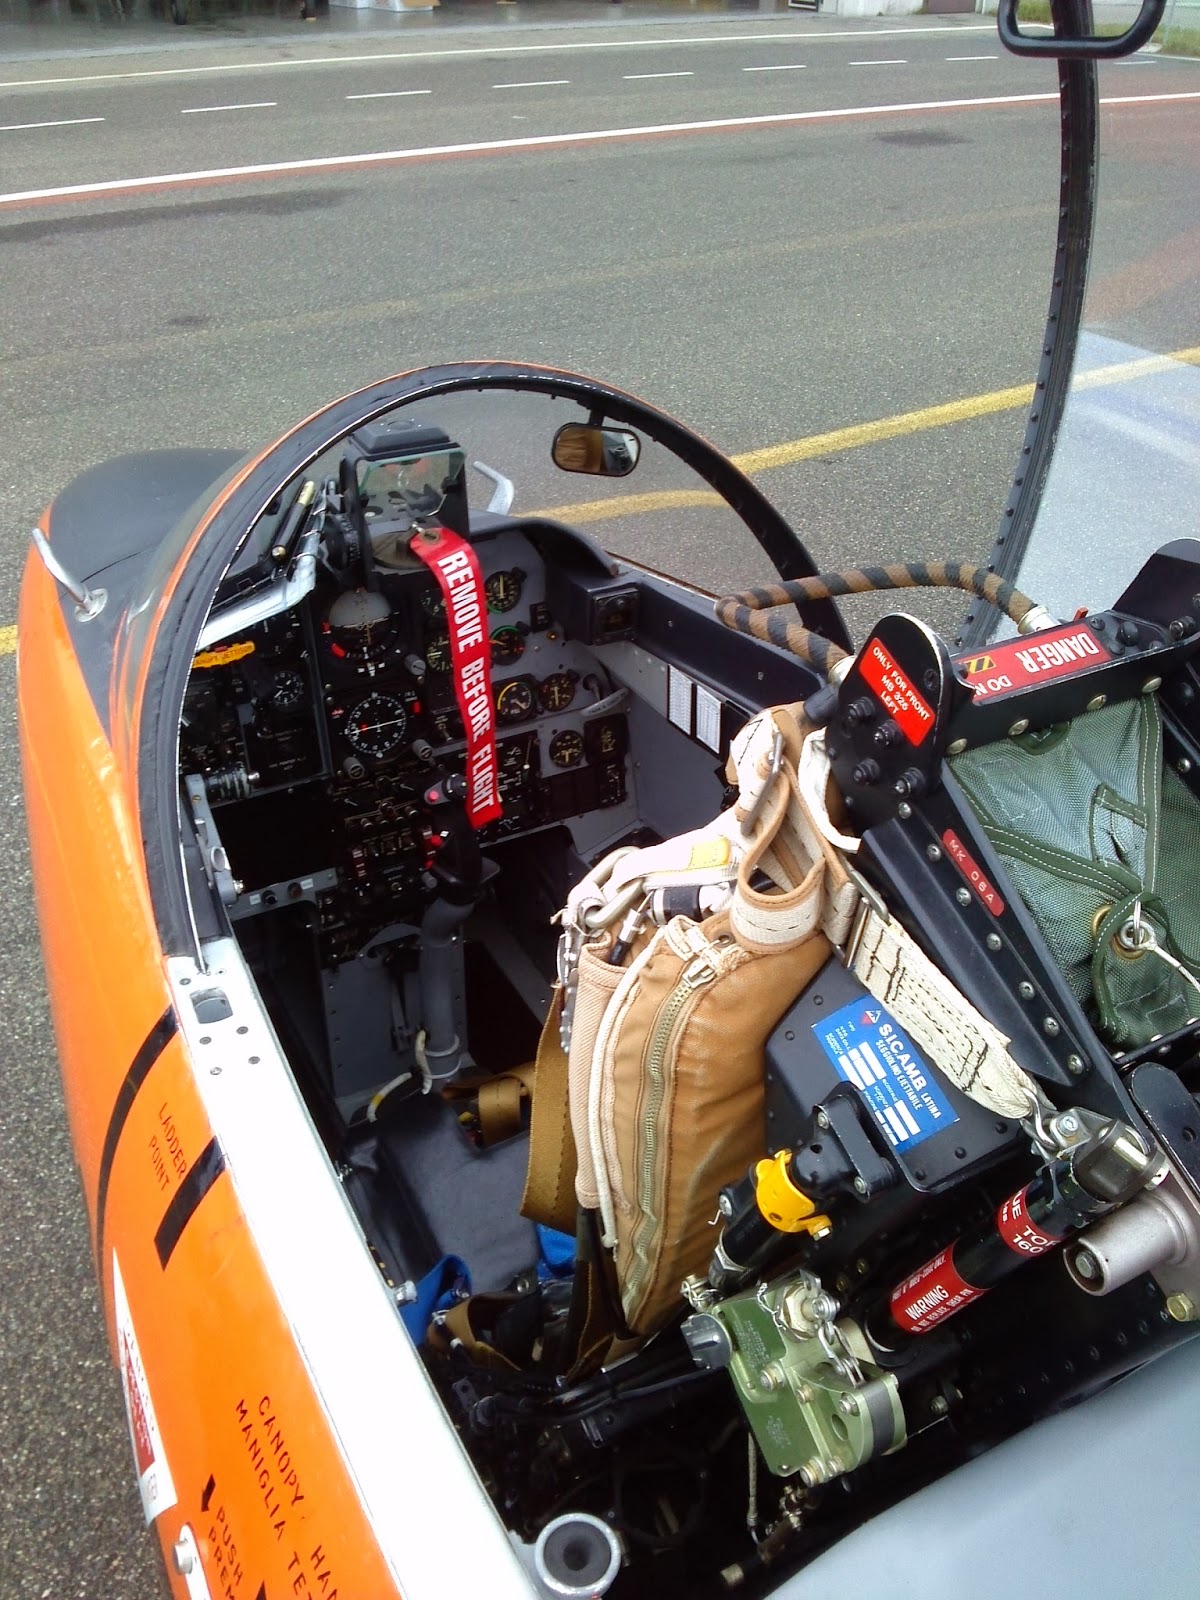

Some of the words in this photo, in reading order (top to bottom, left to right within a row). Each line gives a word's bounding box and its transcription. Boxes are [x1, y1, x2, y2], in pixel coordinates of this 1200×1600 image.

[437, 550, 483, 653] REMOVE
[1014, 632, 1100, 673] DANGER
[460, 656, 491, 739] BEFORE
[872, 646, 892, 671] ONLY
[890, 669, 907, 690] FOR
[905, 688, 931, 722] FRONT
[880, 691, 900, 715] LEFT
[881, 674, 896, 693] MB
[894, 691, 909, 712] 326
[987, 675, 1013, 692] DO
[472, 742, 495, 814] FLIGHT
[949, 839, 966, 862] MK
[875, 1039, 901, 1076] SEGGIOLINO
[921, 1093, 941, 1119] LATINA
[148, 1135, 171, 1192] POINT
[158, 1102, 189, 1180] LADDER
[1013, 1233, 1044, 1254] 160
[905, 1284, 948, 1320] WARNING
[258, 1395, 305, 1506] CANOPY
[236, 1399, 287, 1542] MANIGLIA
[288, 1551, 312, 1600] TE
[216, 1506, 244, 1587] PUSH
